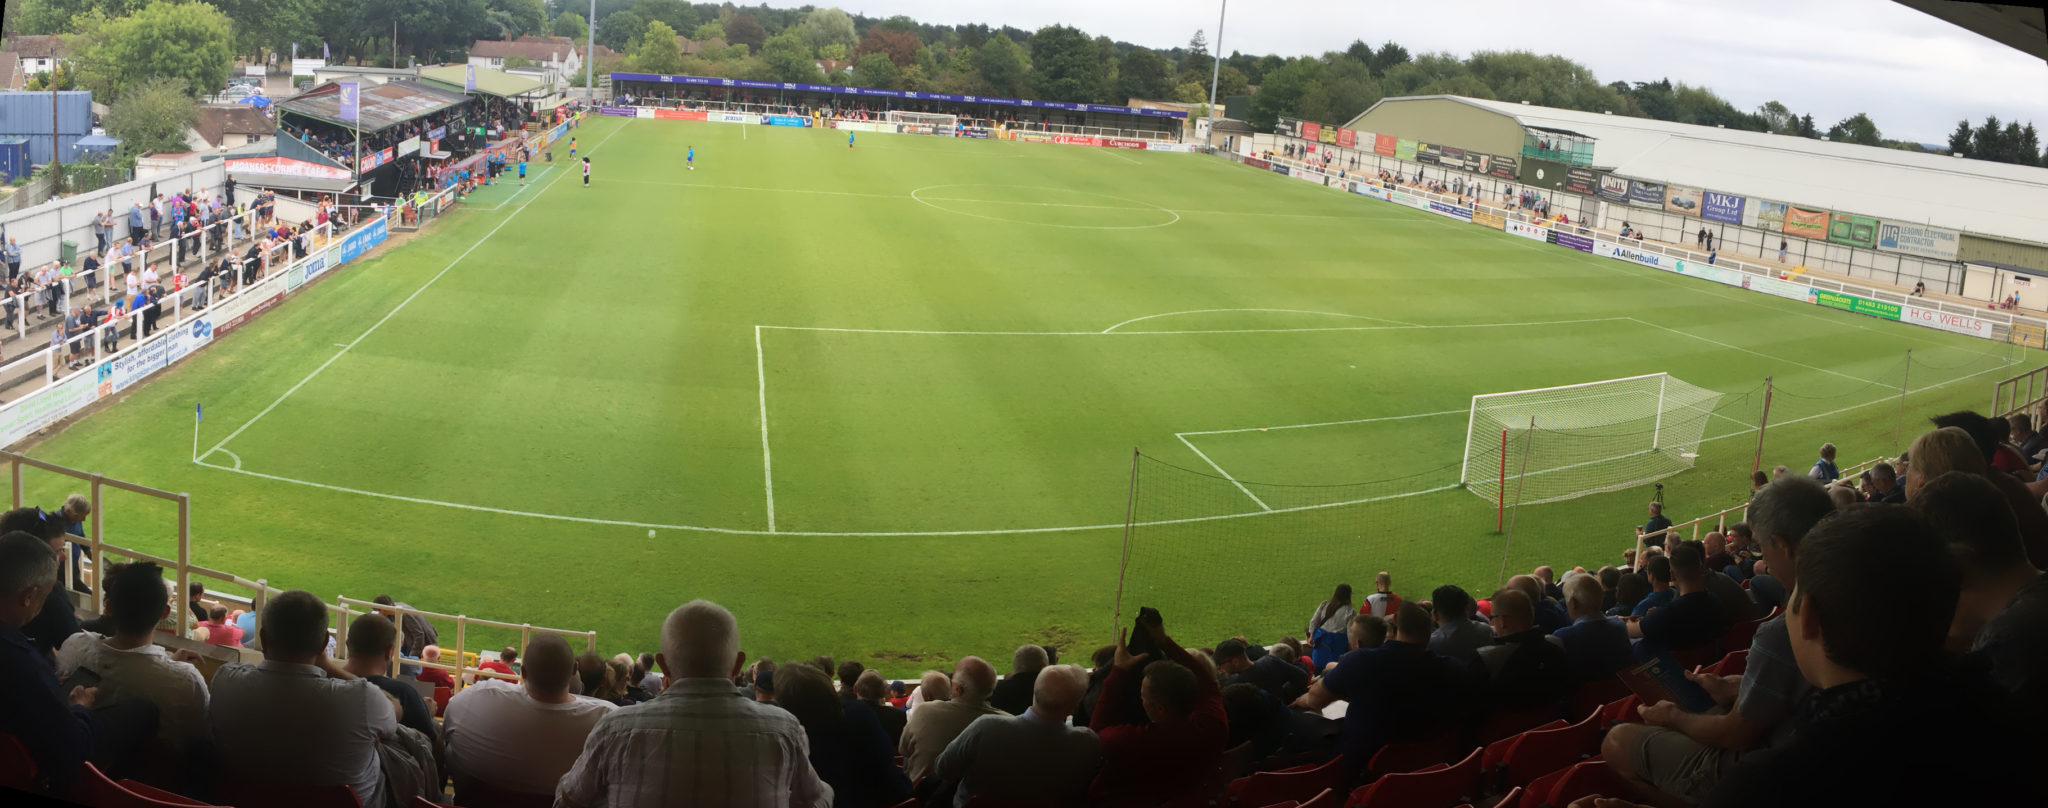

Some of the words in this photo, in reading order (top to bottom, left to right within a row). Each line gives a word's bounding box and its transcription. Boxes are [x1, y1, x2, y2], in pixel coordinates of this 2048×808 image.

[1708, 193, 1740, 209] MKJ
[1707, 205, 1726, 215] Group
[1727, 208, 1738, 216] Ltd
[1900, 235, 1934, 247] CONTRACTOR
[1901, 226, 1923, 237] LEADING
[1924, 229, 1955, 241] ELECTRICAL
[1620, 249, 1659, 265] Allenbuild
[1939, 313, 1982, 331] WELLS
[137, 337, 167, 358] affordable
[147, 349, 164, 362] bigger
